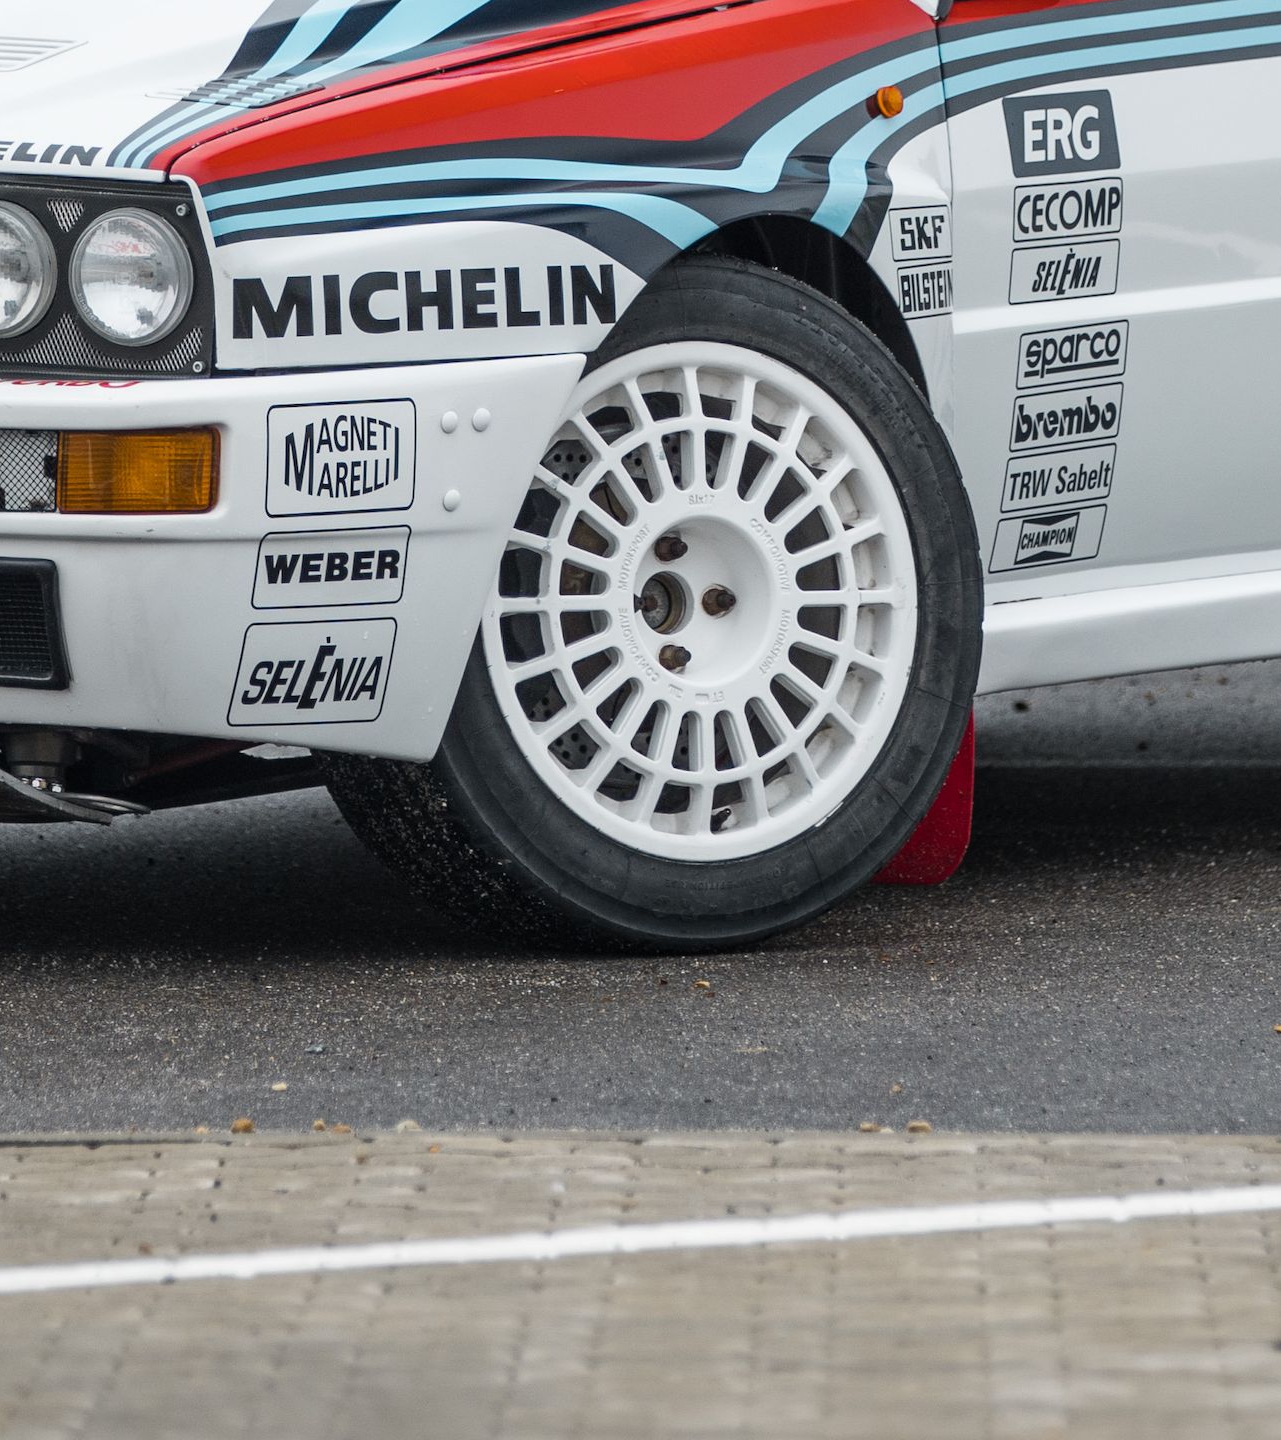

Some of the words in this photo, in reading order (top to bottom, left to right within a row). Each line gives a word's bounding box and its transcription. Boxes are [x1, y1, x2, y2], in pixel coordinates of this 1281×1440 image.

[1023, 104, 1101, 164] ERG
[1017, 186, 1121, 234] CECOMP
[899, 215, 945, 252] SKF
[232, 263, 617, 340] MICHELIN
[900, 268, 954, 313] BILSTEIN
[1025, 328, 1121, 378] sparco
[1015, 396, 1117, 444] brembo
[1009, 468, 1053, 501] TRW
[1055, 460, 1111, 495] Sabelt
[1020, 526, 1075, 550] CHAMPION
[264, 549, 401, 585] WEBER
